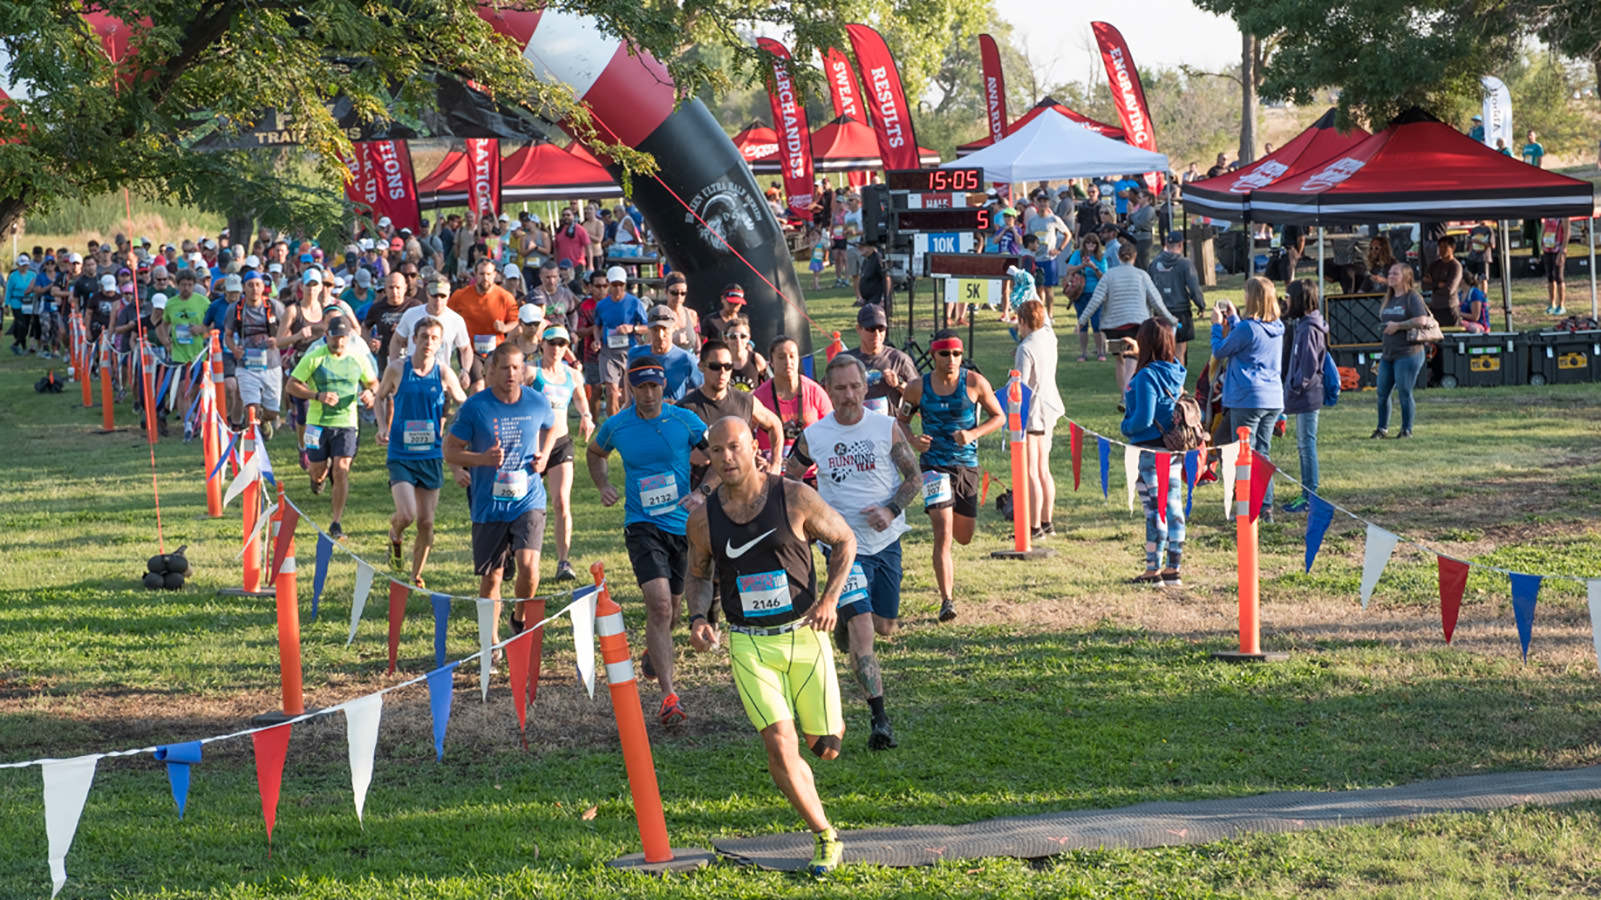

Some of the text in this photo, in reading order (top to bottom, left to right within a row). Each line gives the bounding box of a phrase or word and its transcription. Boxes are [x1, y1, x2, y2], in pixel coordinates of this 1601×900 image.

[833, 61, 856, 115] SWEAT
[1109, 47, 1148, 145] ENGRAVING
[871, 66, 904, 148] RESULTS
[987, 77, 1003, 143] AWARDS
[254, 131, 304, 144] TRAI
[976, 210, 989, 230] 5
[933, 237, 955, 253] 10K
[966, 283, 981, 299] 5K
[828, 453, 875, 468] RUNNING
[856, 463, 876, 472] TEAM
[649, 494, 671, 505] 2132
[752, 599, 781, 610] 2146
